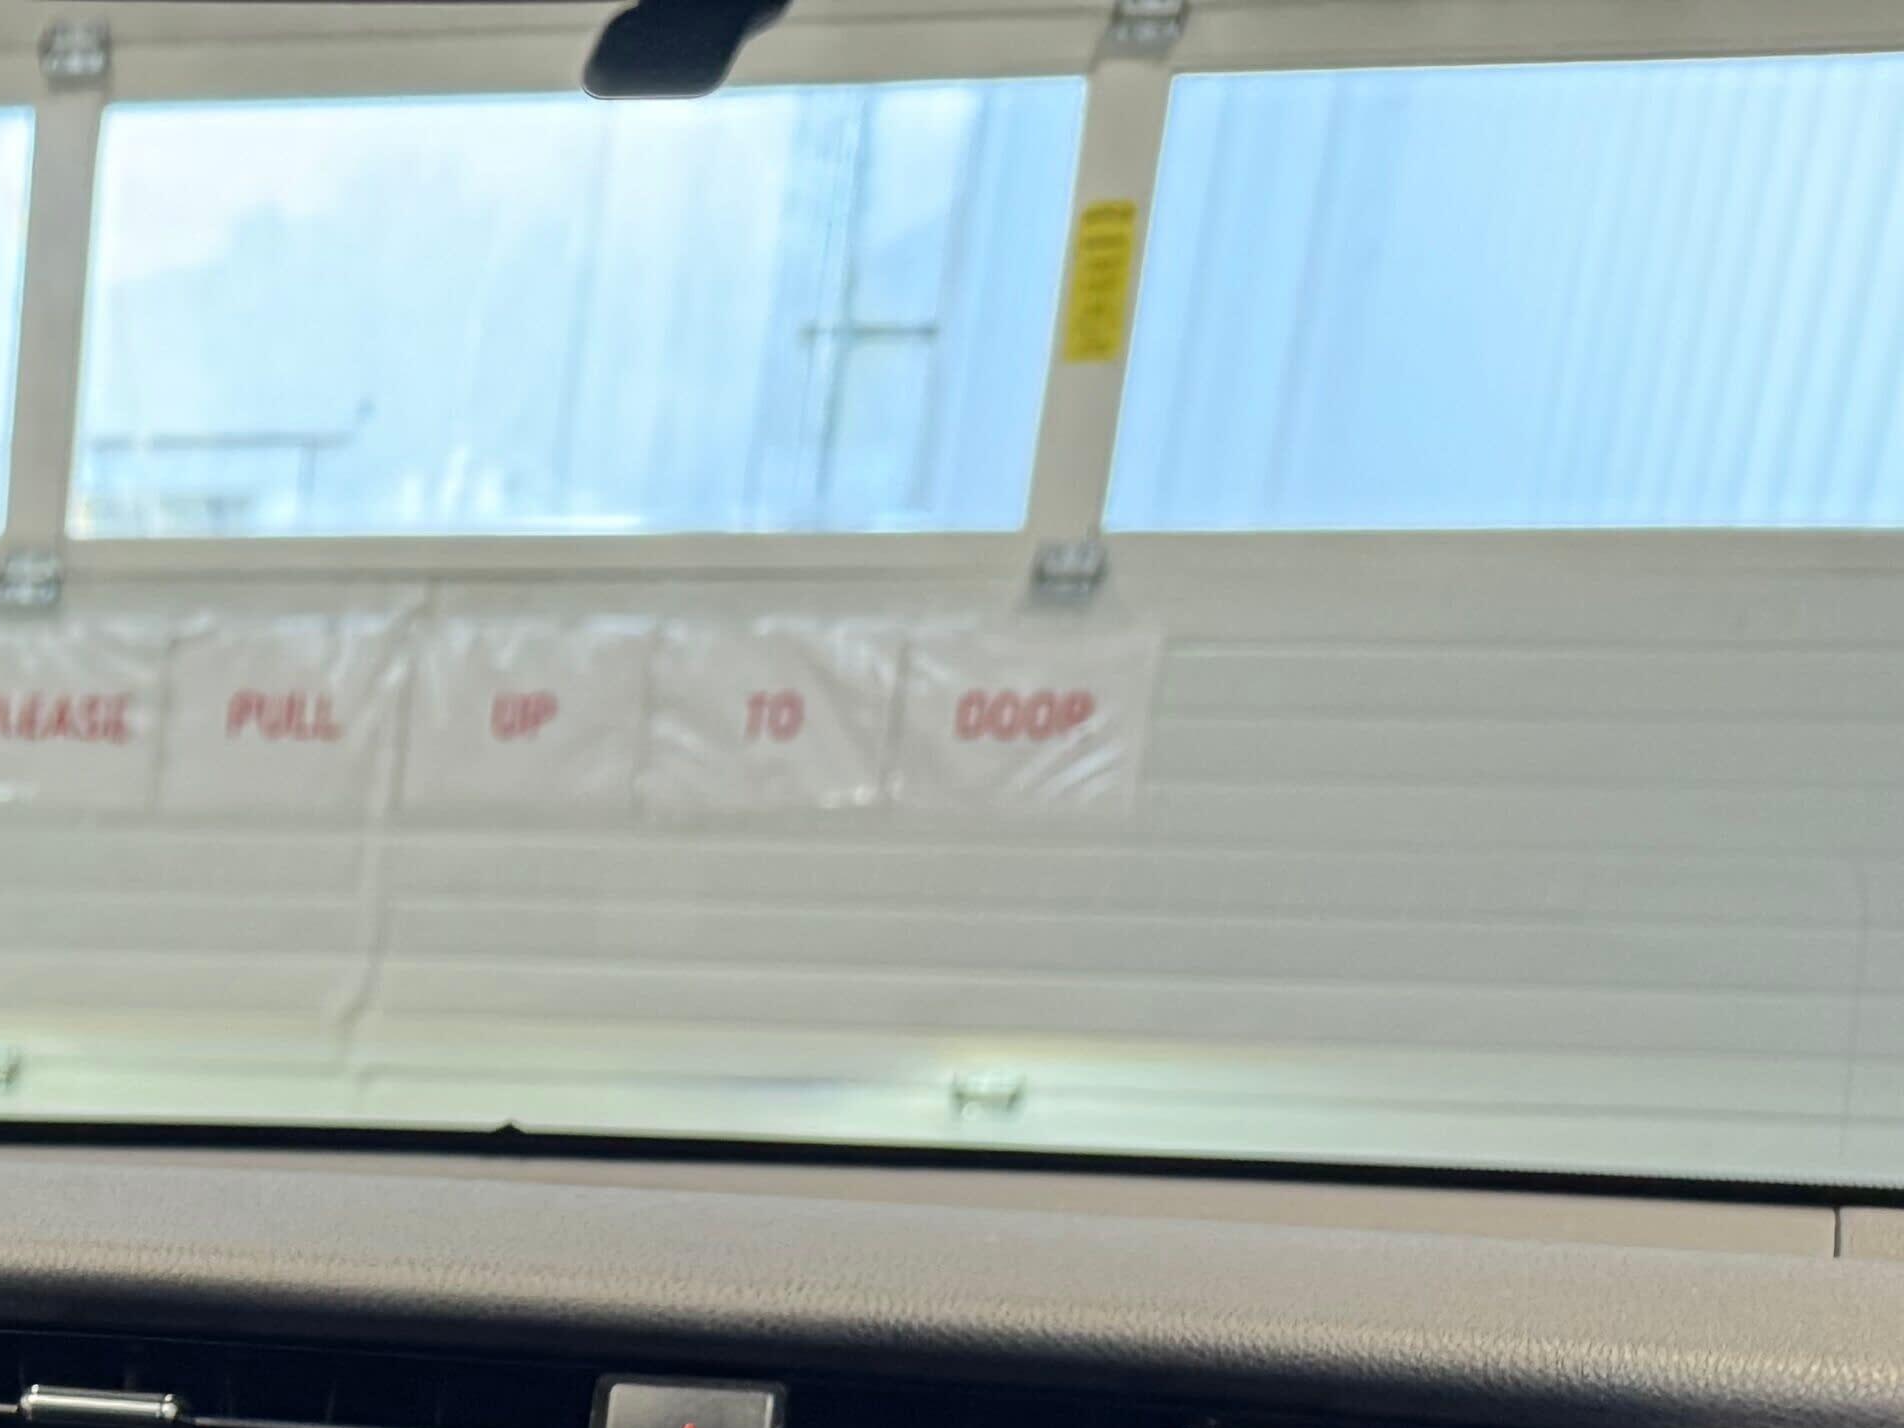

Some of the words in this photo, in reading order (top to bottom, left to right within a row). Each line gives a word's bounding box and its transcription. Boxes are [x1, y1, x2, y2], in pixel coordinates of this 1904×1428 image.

[226, 690, 345, 742] PULL
[491, 689, 559, 742] UP
[745, 688, 805, 743] TO
